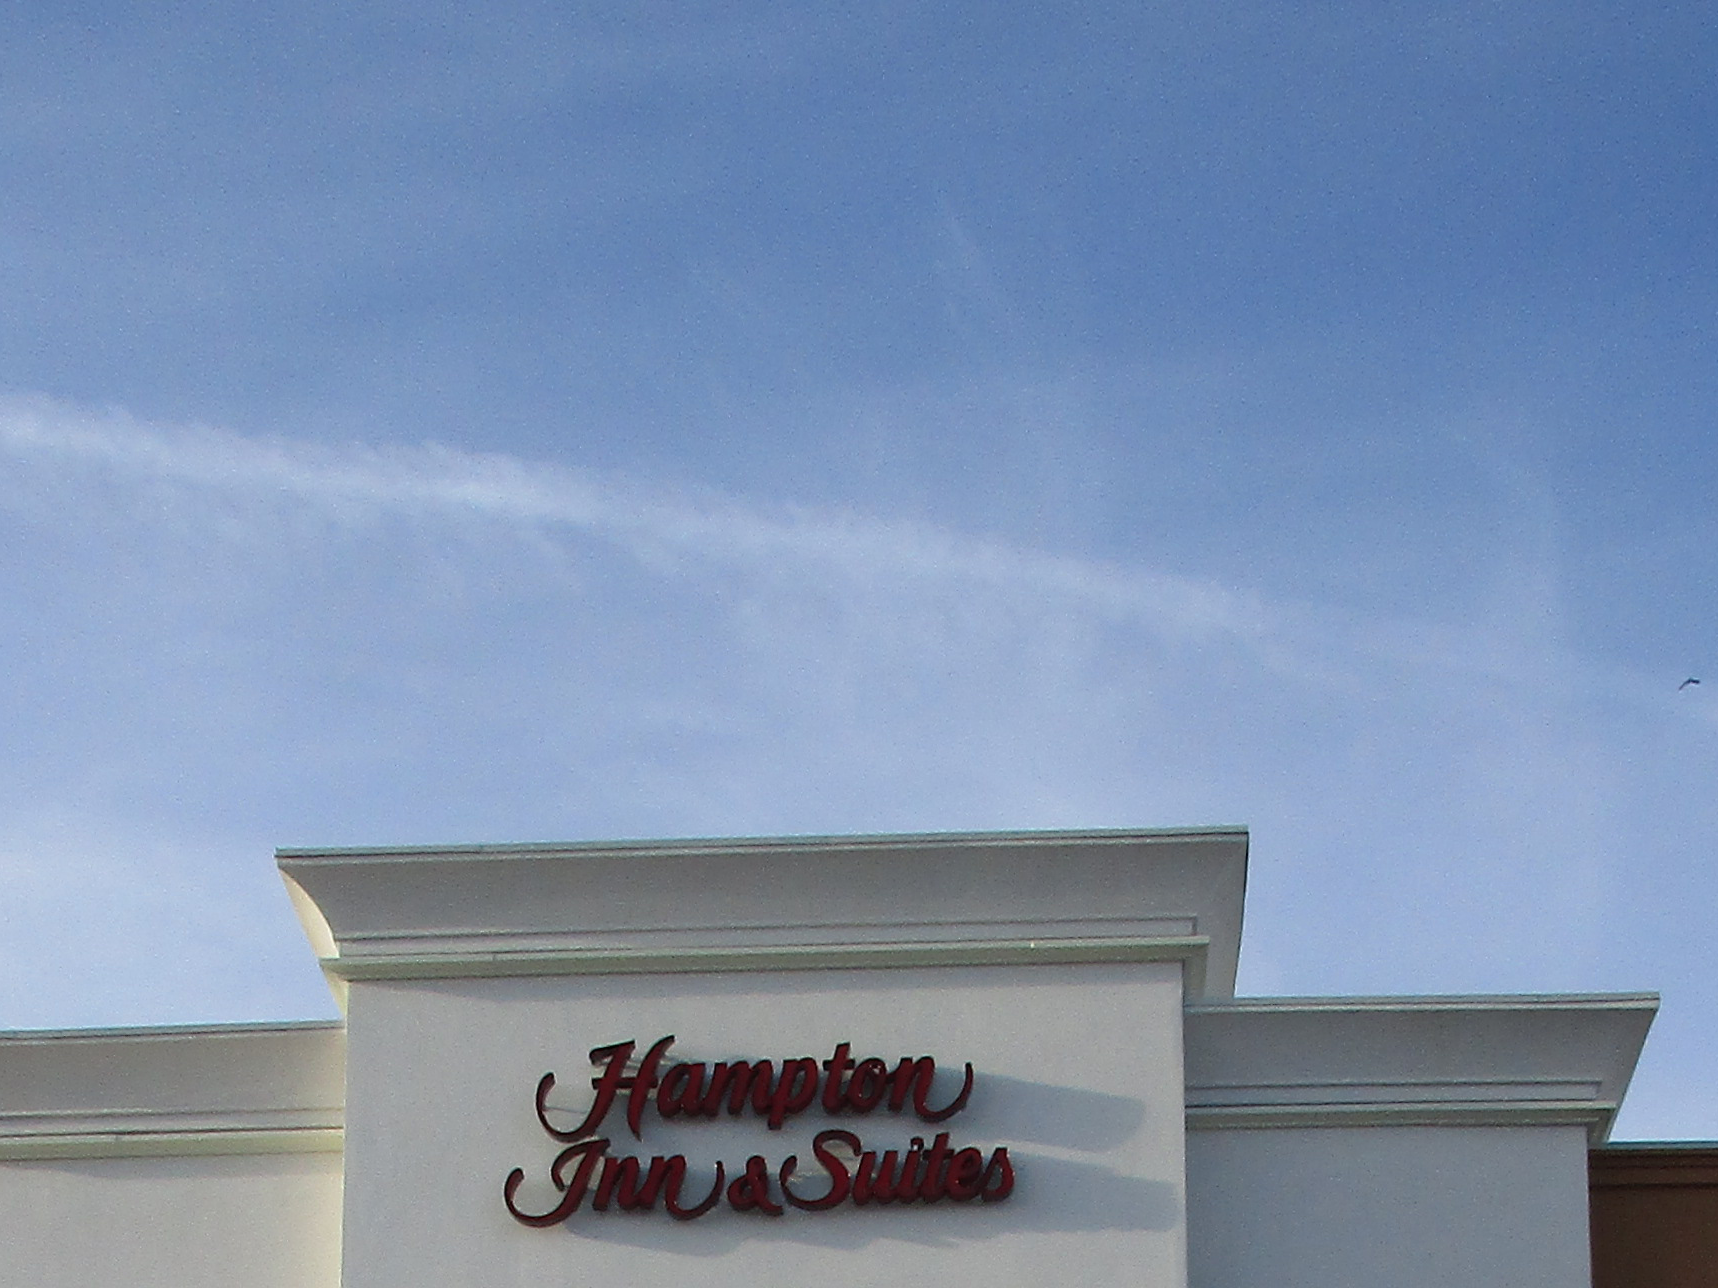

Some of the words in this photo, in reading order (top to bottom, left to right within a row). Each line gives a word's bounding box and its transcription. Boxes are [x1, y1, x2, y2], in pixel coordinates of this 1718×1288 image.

[535, 1034, 974, 1142] Hampton
[503, 1137, 724, 1228] Inn
[726, 1154, 784, 1216] &
[780, 1128, 1015, 1212] Suites
